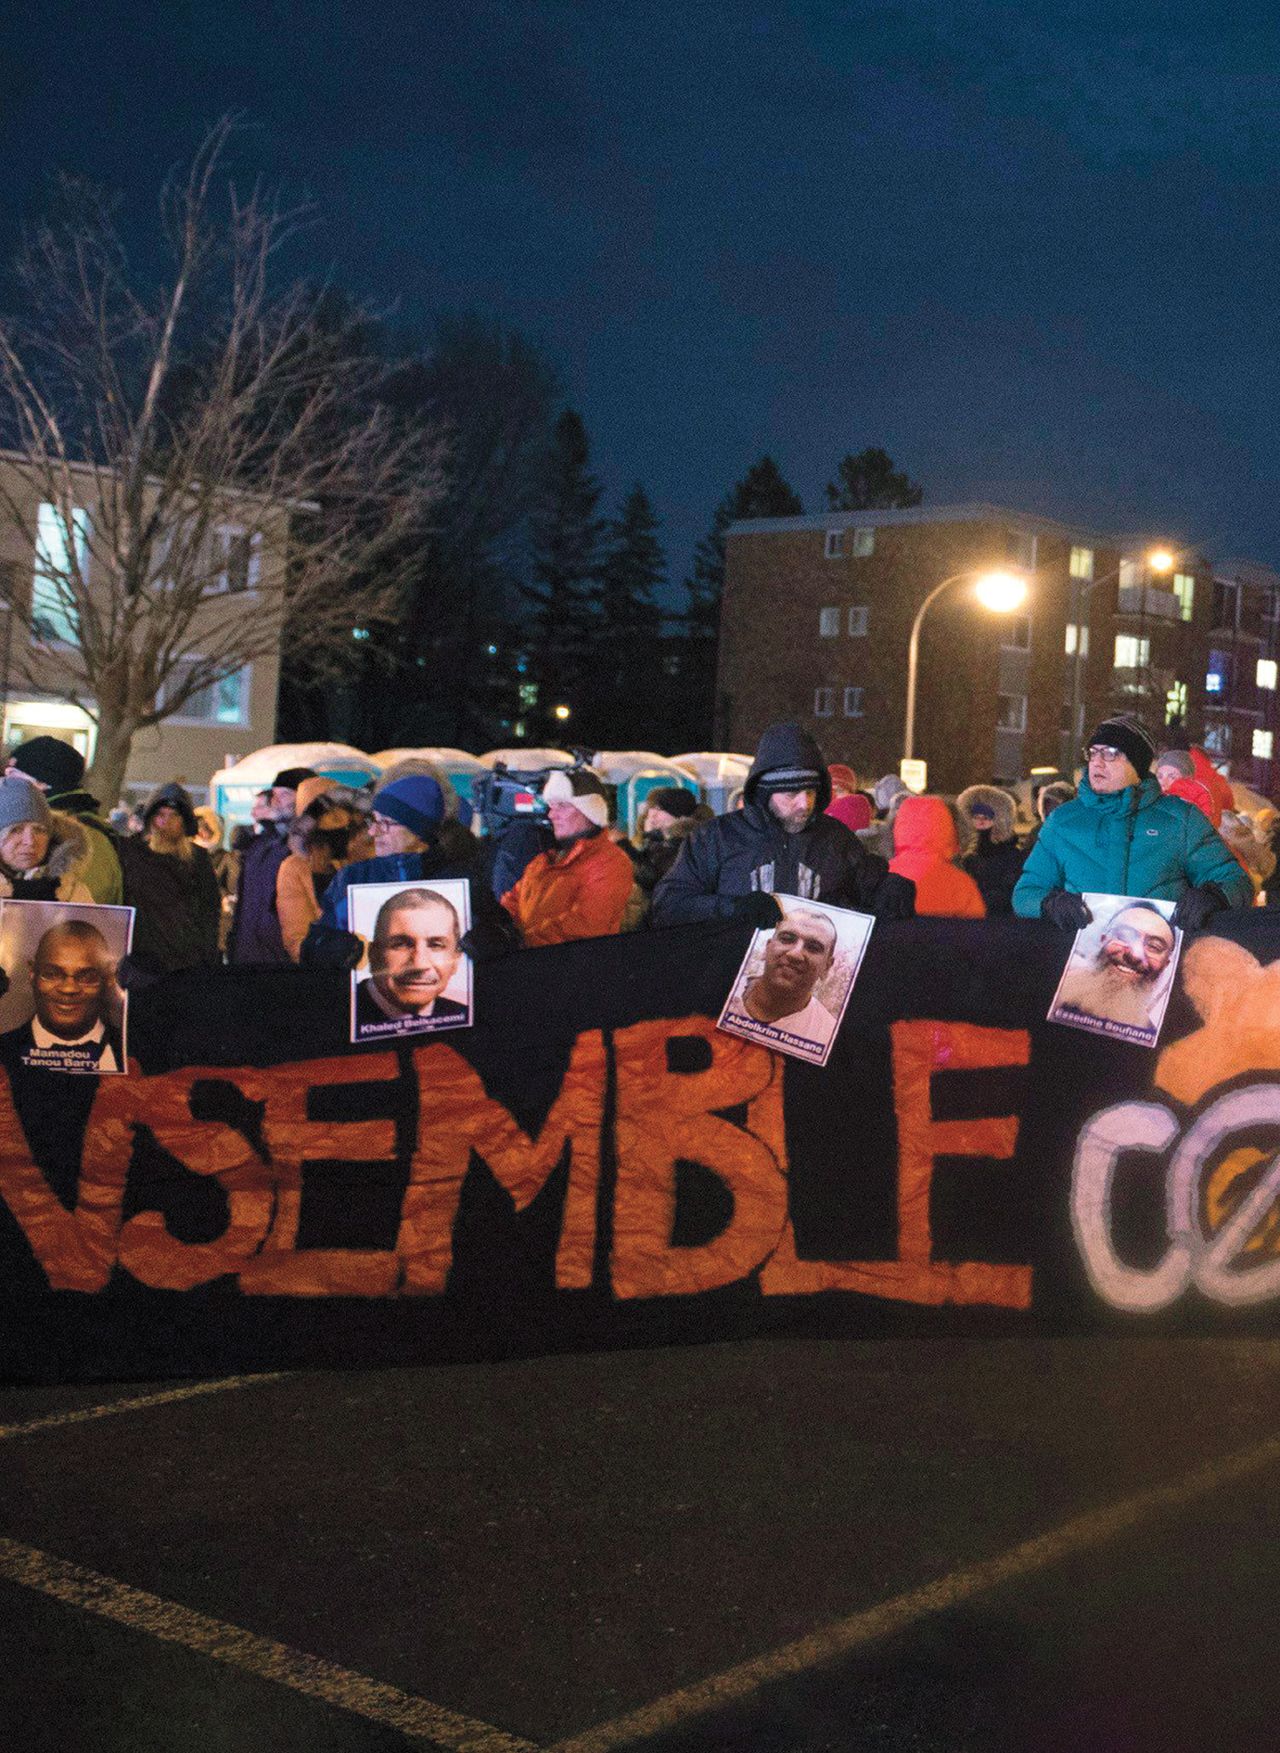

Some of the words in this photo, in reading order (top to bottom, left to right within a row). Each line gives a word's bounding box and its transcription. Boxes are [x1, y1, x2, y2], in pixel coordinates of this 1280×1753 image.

[360, 1021, 402, 1034] Khaled
[727, 1014, 779, 1039] Abdelkrim
[779, 1031, 823, 1055] Hassane
[29, 1048, 90, 1059] Mamadou
[21, 1056, 61, 1067] Tanou
[63, 1057, 99, 1070] Barry
